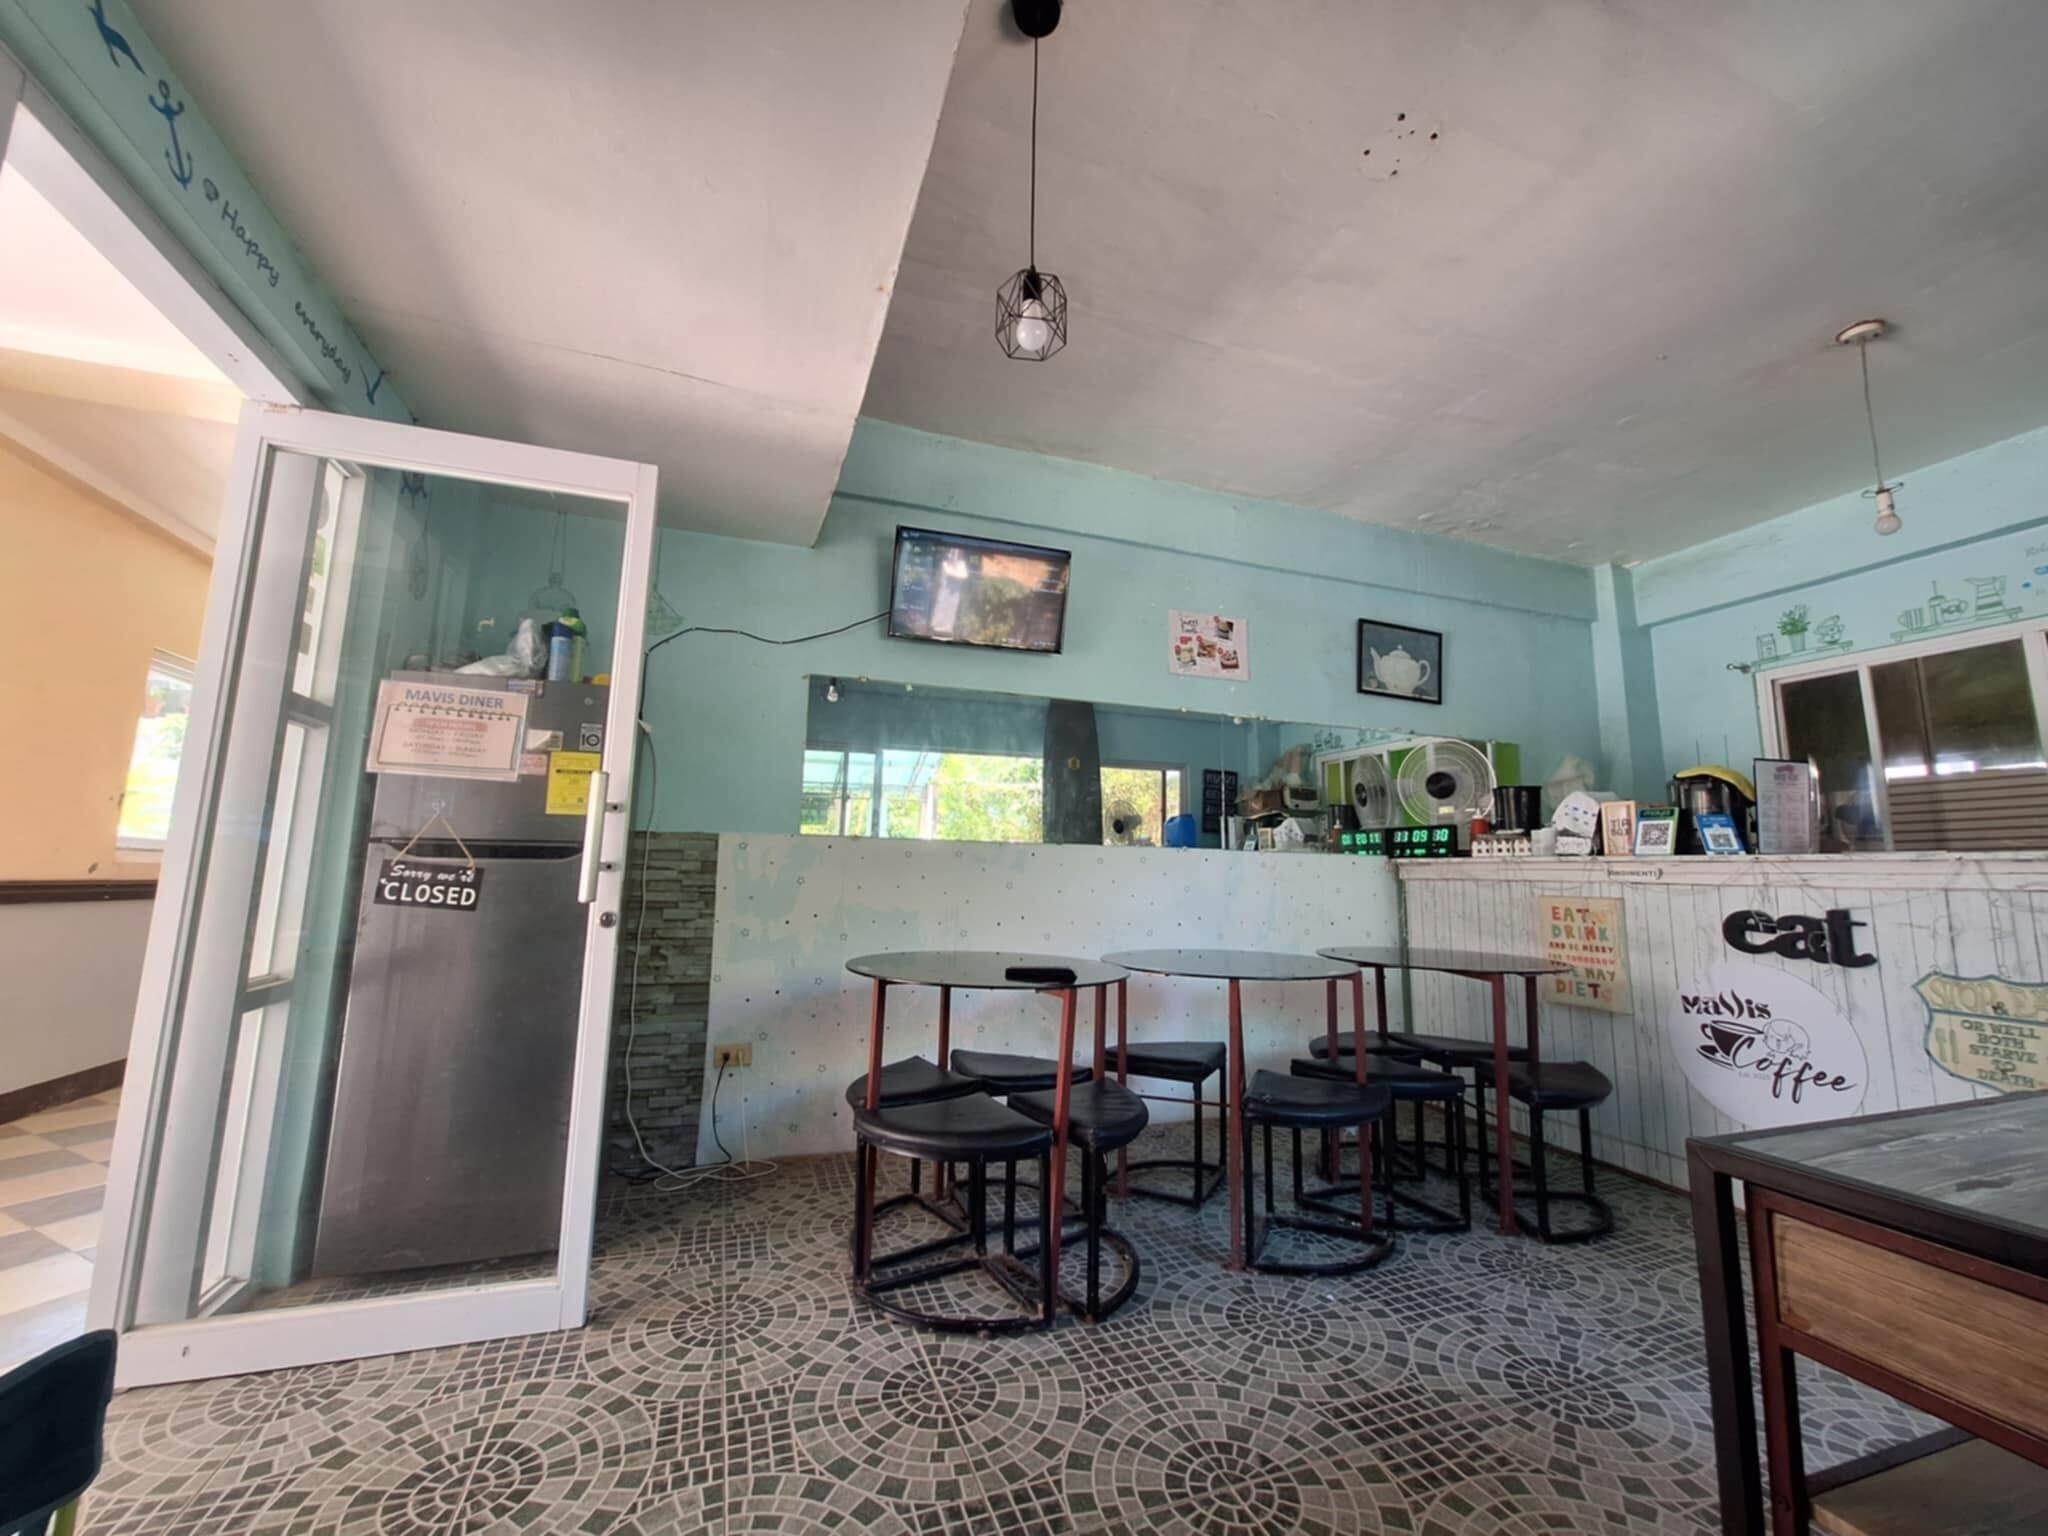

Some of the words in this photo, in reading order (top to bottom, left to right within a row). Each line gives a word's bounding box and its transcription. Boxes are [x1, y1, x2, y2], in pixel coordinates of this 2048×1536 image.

[221, 200, 279, 287] Happy
[295, 301, 351, 384] everyday
[405, 688, 455, 704] MAVIS
[458, 694, 504, 709] DINER
[390, 864, 432, 881] Sorry
[384, 881, 476, 906] CLOSED
[1552, 924, 1609, 942] DRINK
[1722, 909, 1878, 968] eat
[1549, 942, 1566, 950] AND
[1582, 944, 1614, 954] MERRY
[1567, 954, 1616, 966] TOMORROW
[1584, 968, 1616, 982] MAY
[1961, 1019, 1987, 1032] OR
[1977, 1032, 2026, 1050] BOTH
[1969, 1044, 2039, 1065] STARVE
[1732, 1036, 1857, 1104] Coffee
[1991, 1058, 2017, 1073] TO
[1976, 1067, 2036, 1089] DEATH
